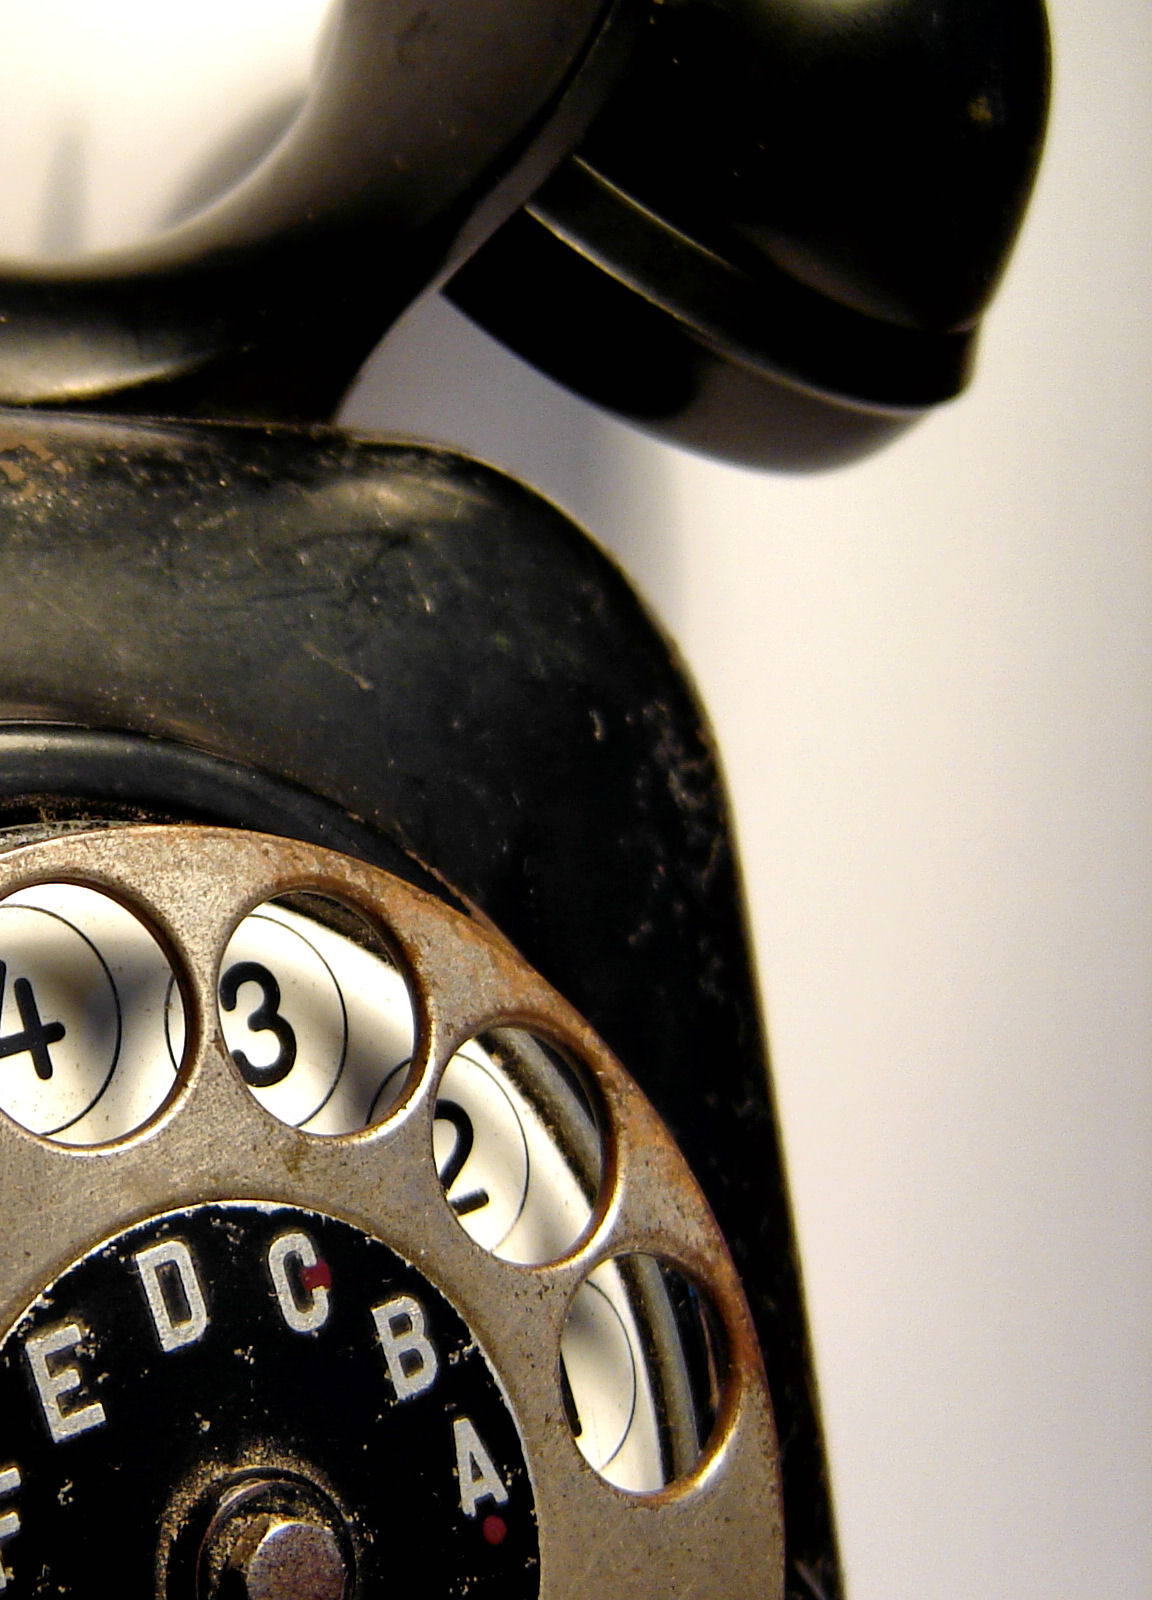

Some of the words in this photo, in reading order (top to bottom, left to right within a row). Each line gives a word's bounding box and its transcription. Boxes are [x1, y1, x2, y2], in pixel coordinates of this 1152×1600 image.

[220, 962, 296, 1087] 3
[434, 1099, 489, 1218] 2
[135, 1239, 208, 1353] D
[268, 1232, 330, 1333] C
[25, 1324, 106, 1444] E
[370, 1296, 439, 1402] B
[452, 1416, 509, 1519] A
